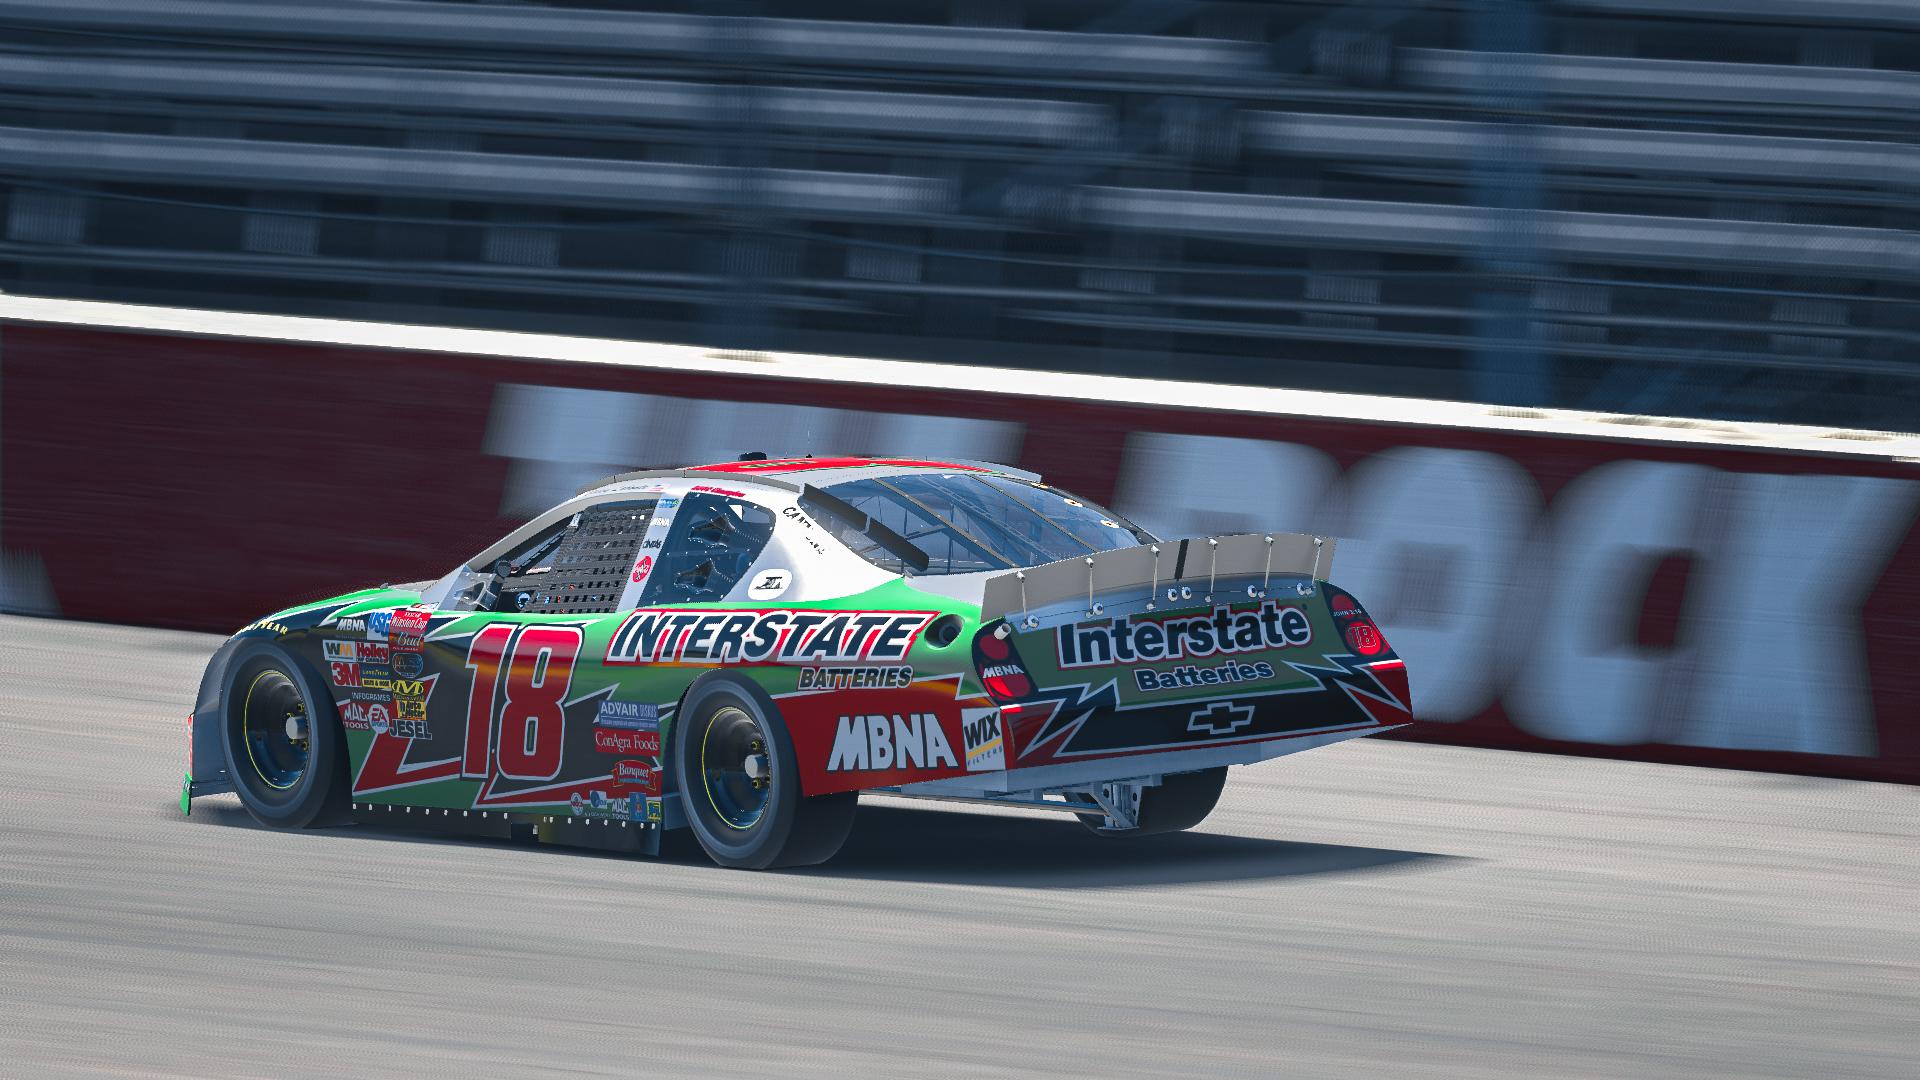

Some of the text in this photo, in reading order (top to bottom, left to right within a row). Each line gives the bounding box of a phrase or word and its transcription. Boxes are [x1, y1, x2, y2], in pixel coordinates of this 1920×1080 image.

[336, 618, 366, 632] MBNA
[390, 616, 428, 631] Winston Cup
[1058, 600, 1312, 668] Interstate
[398, 631, 424, 647] Bud
[606, 610, 936, 664] INTERSTATE
[1347, 625, 1377, 649] 18
[356, 642, 389, 663] Holley
[332, 662, 361, 687] 3M
[797, 665, 914, 692] BATTERIES
[982, 664, 1025, 679] MBNA
[1134, 660, 1275, 692] Batteries
[351, 691, 391, 702] INFOGRAMES
[462, 622, 584, 781] 18
[344, 703, 369, 721] MAC
[600, 701, 639, 717] ADVAIR
[344, 721, 369, 730] TOOLS
[389, 719, 433, 741] JESEL
[963, 711, 1001, 750] WIX
[595, 731, 659, 753] ConAgra Foods
[826, 712, 959, 772] MBNA
[967, 744, 1003, 767] FILTERS
[619, 762, 650, 779] Banquet
